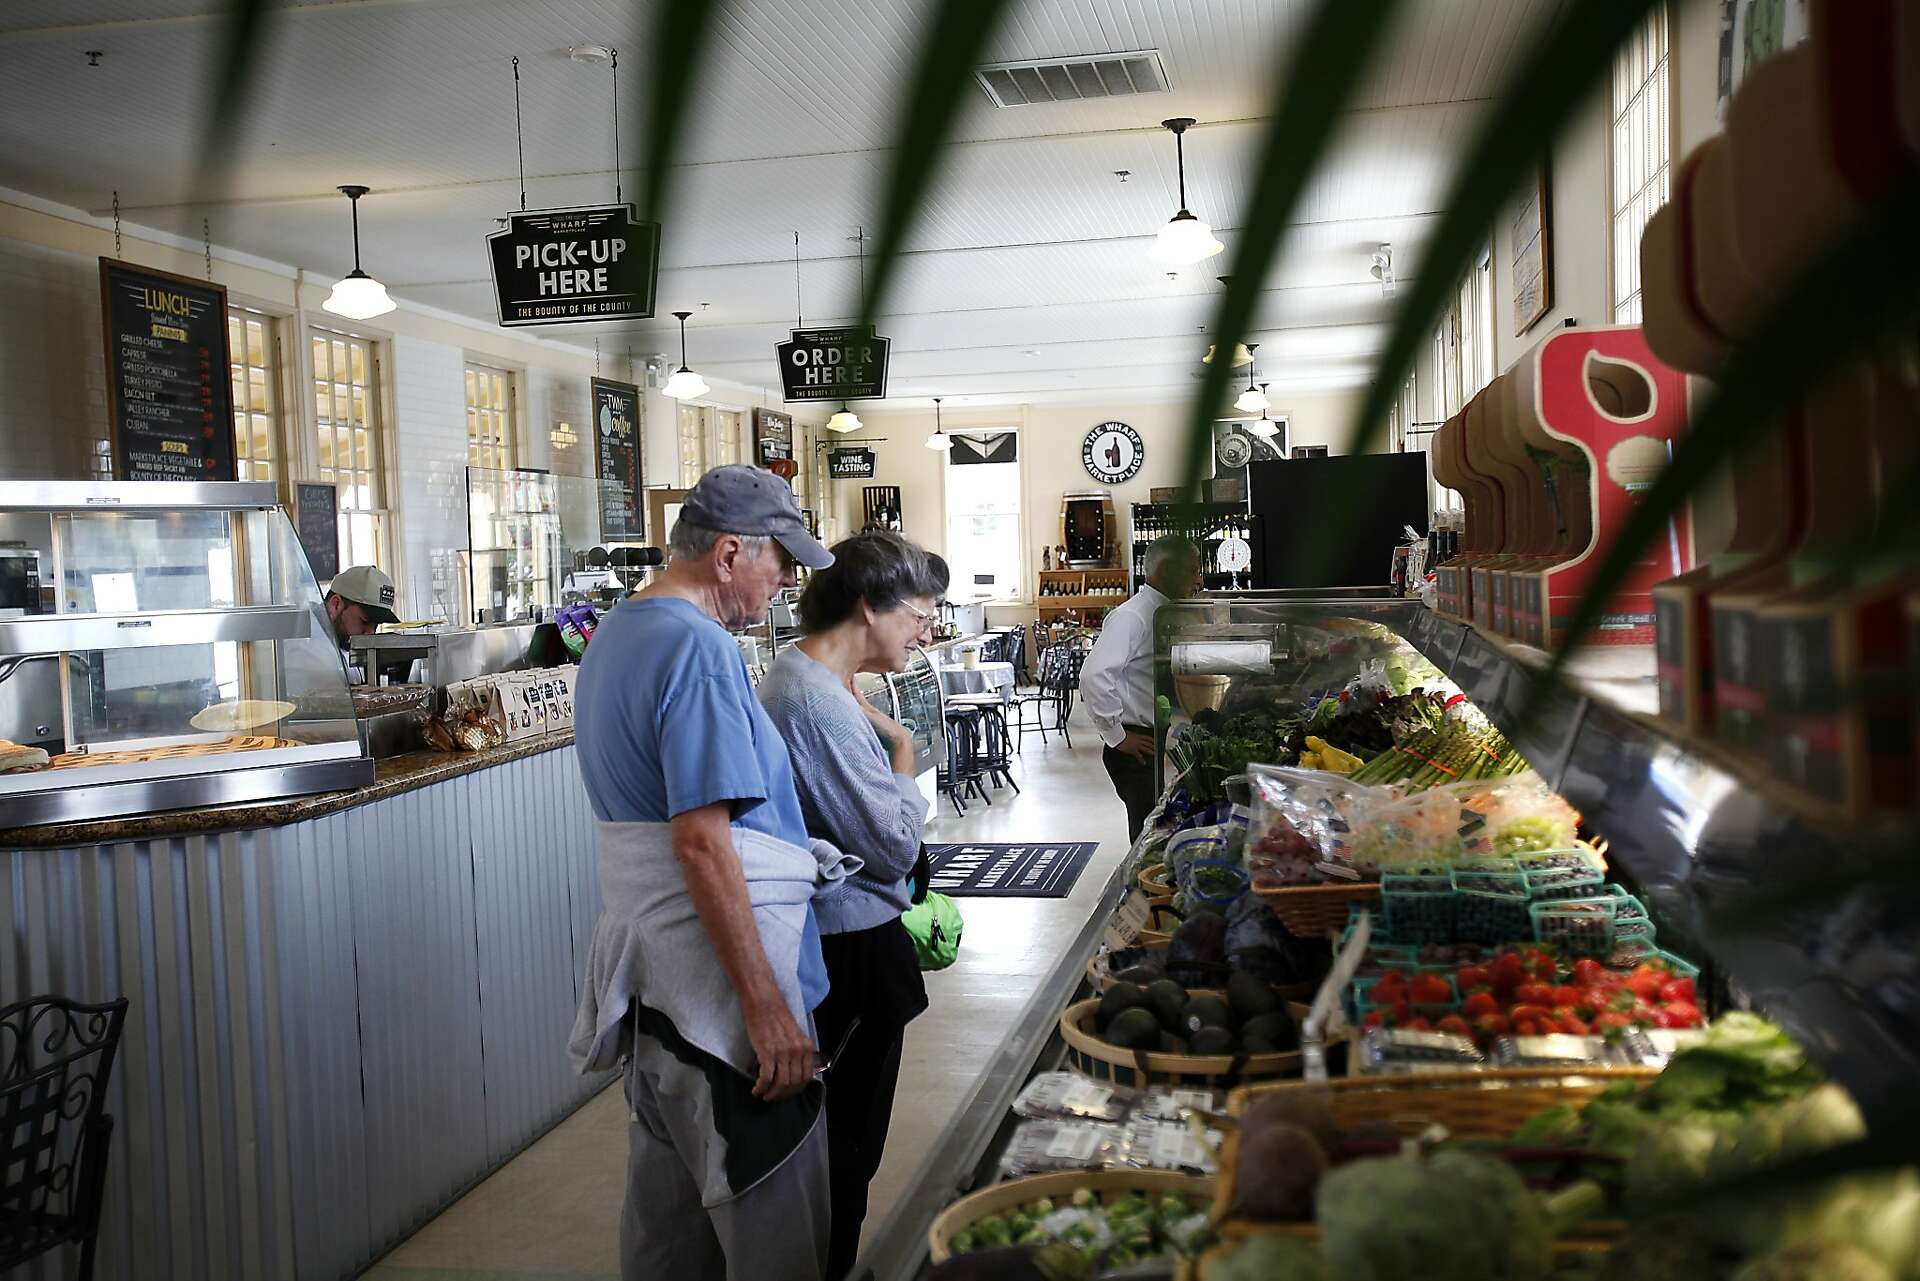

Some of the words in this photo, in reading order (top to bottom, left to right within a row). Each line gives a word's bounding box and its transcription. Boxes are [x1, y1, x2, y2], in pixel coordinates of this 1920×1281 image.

[552, 220, 587, 229] WHARF
[516, 238, 627, 269] PICK-UP
[539, 268, 608, 296] HERE
[144, 287, 190, 316] LUNCH
[518, 308, 532, 317] THE
[535, 305, 566, 316] BOUNTY
[569, 305, 579, 314] OF
[583, 303, 597, 313] THE
[600, 301, 632, 311] COUNTY
[791, 346, 873, 367] ORDER
[805, 366, 863, 385] HERE
[1085, 427, 1103, 446] THE
[1105, 423, 1141, 444] WHARF
[833, 463, 871, 472] TASTING
[840, 455, 863, 464] WINE
[1083, 452, 1143, 483] MARKETPLACE
[928, 847, 995, 888] WHARF
[975, 847, 1026, 888] MARKETPLACE
